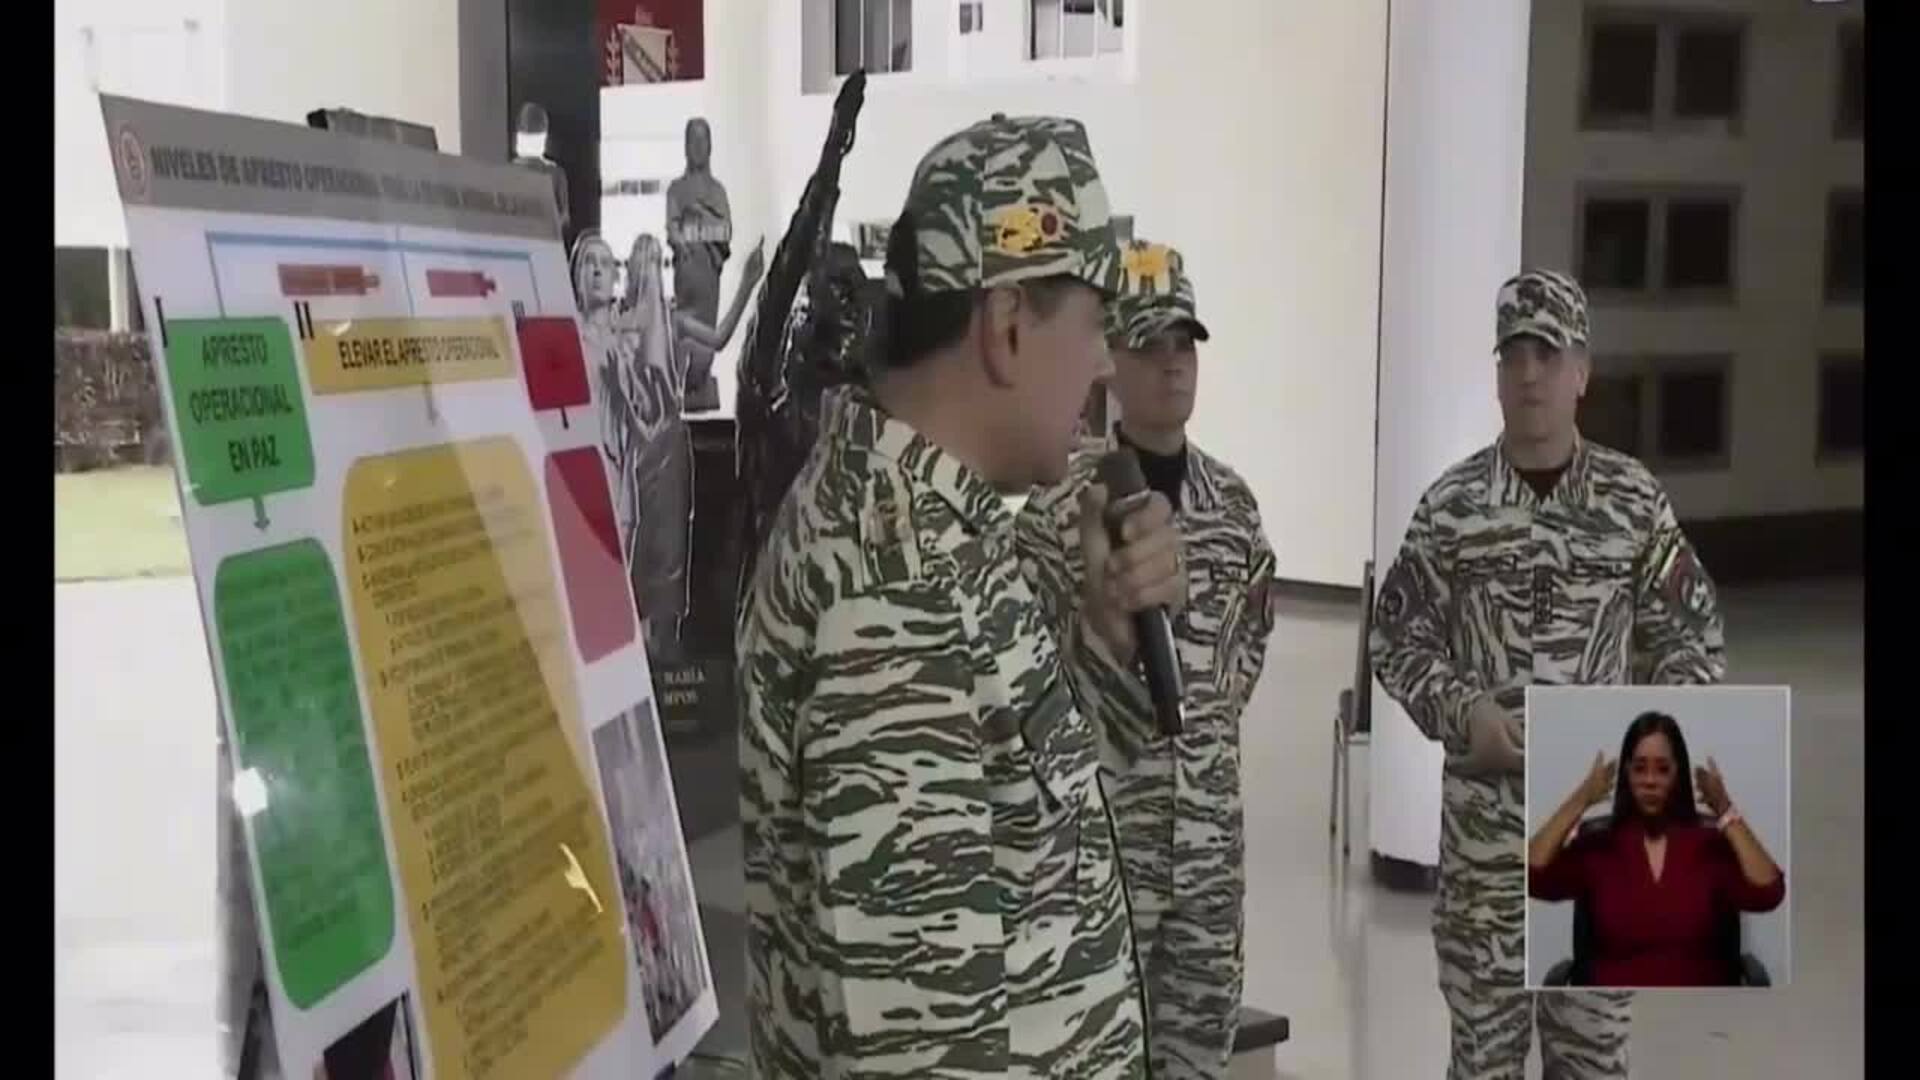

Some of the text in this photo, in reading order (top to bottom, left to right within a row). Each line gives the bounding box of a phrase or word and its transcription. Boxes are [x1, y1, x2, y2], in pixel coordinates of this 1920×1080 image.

[202, 332, 269, 369] APRESTO
[338, 338, 384, 370] ELEVAR
[382, 338, 399, 366] EL
[189, 384, 294, 425] OPERACIONAL
[227, 433, 281, 473] EN PAZ
